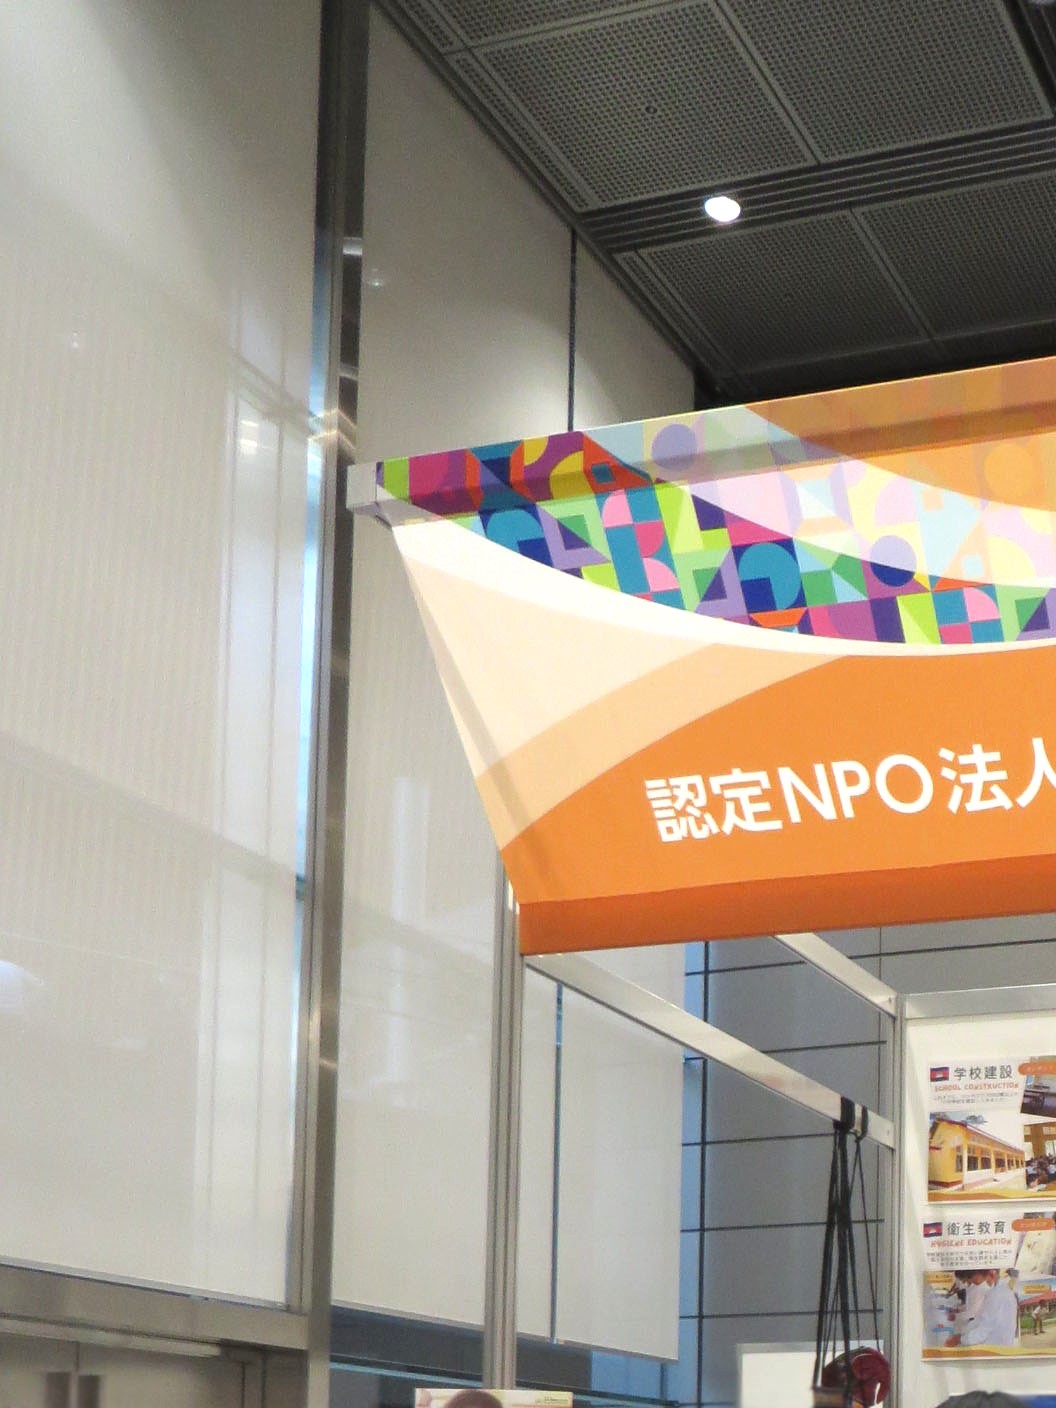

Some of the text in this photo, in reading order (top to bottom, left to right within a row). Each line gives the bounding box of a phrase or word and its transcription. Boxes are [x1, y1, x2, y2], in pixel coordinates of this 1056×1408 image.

[954, 1065, 1013, 1081] 学校建設
[947, 1221, 1006, 1236] 衛生教育
[967, 1238, 1012, 1246] EDUCATION
